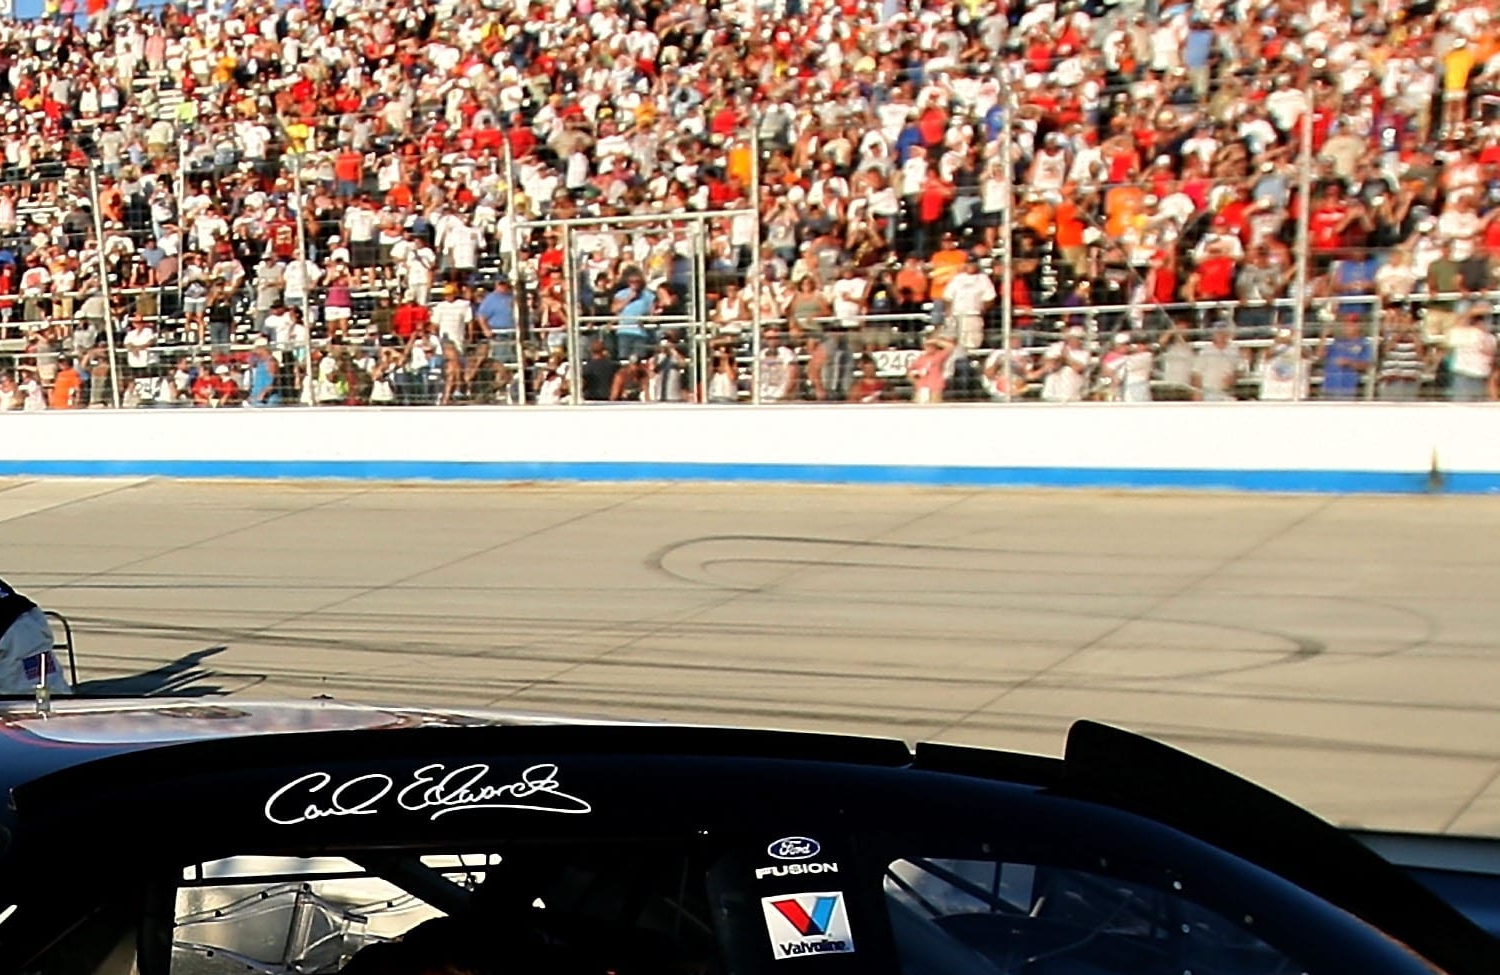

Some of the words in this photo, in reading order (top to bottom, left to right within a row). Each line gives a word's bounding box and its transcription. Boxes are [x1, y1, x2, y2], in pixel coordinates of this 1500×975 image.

[778, 840, 811, 856] Ford
[754, 862, 839, 880] FUSION
[779, 938, 846, 957] Valvoline
